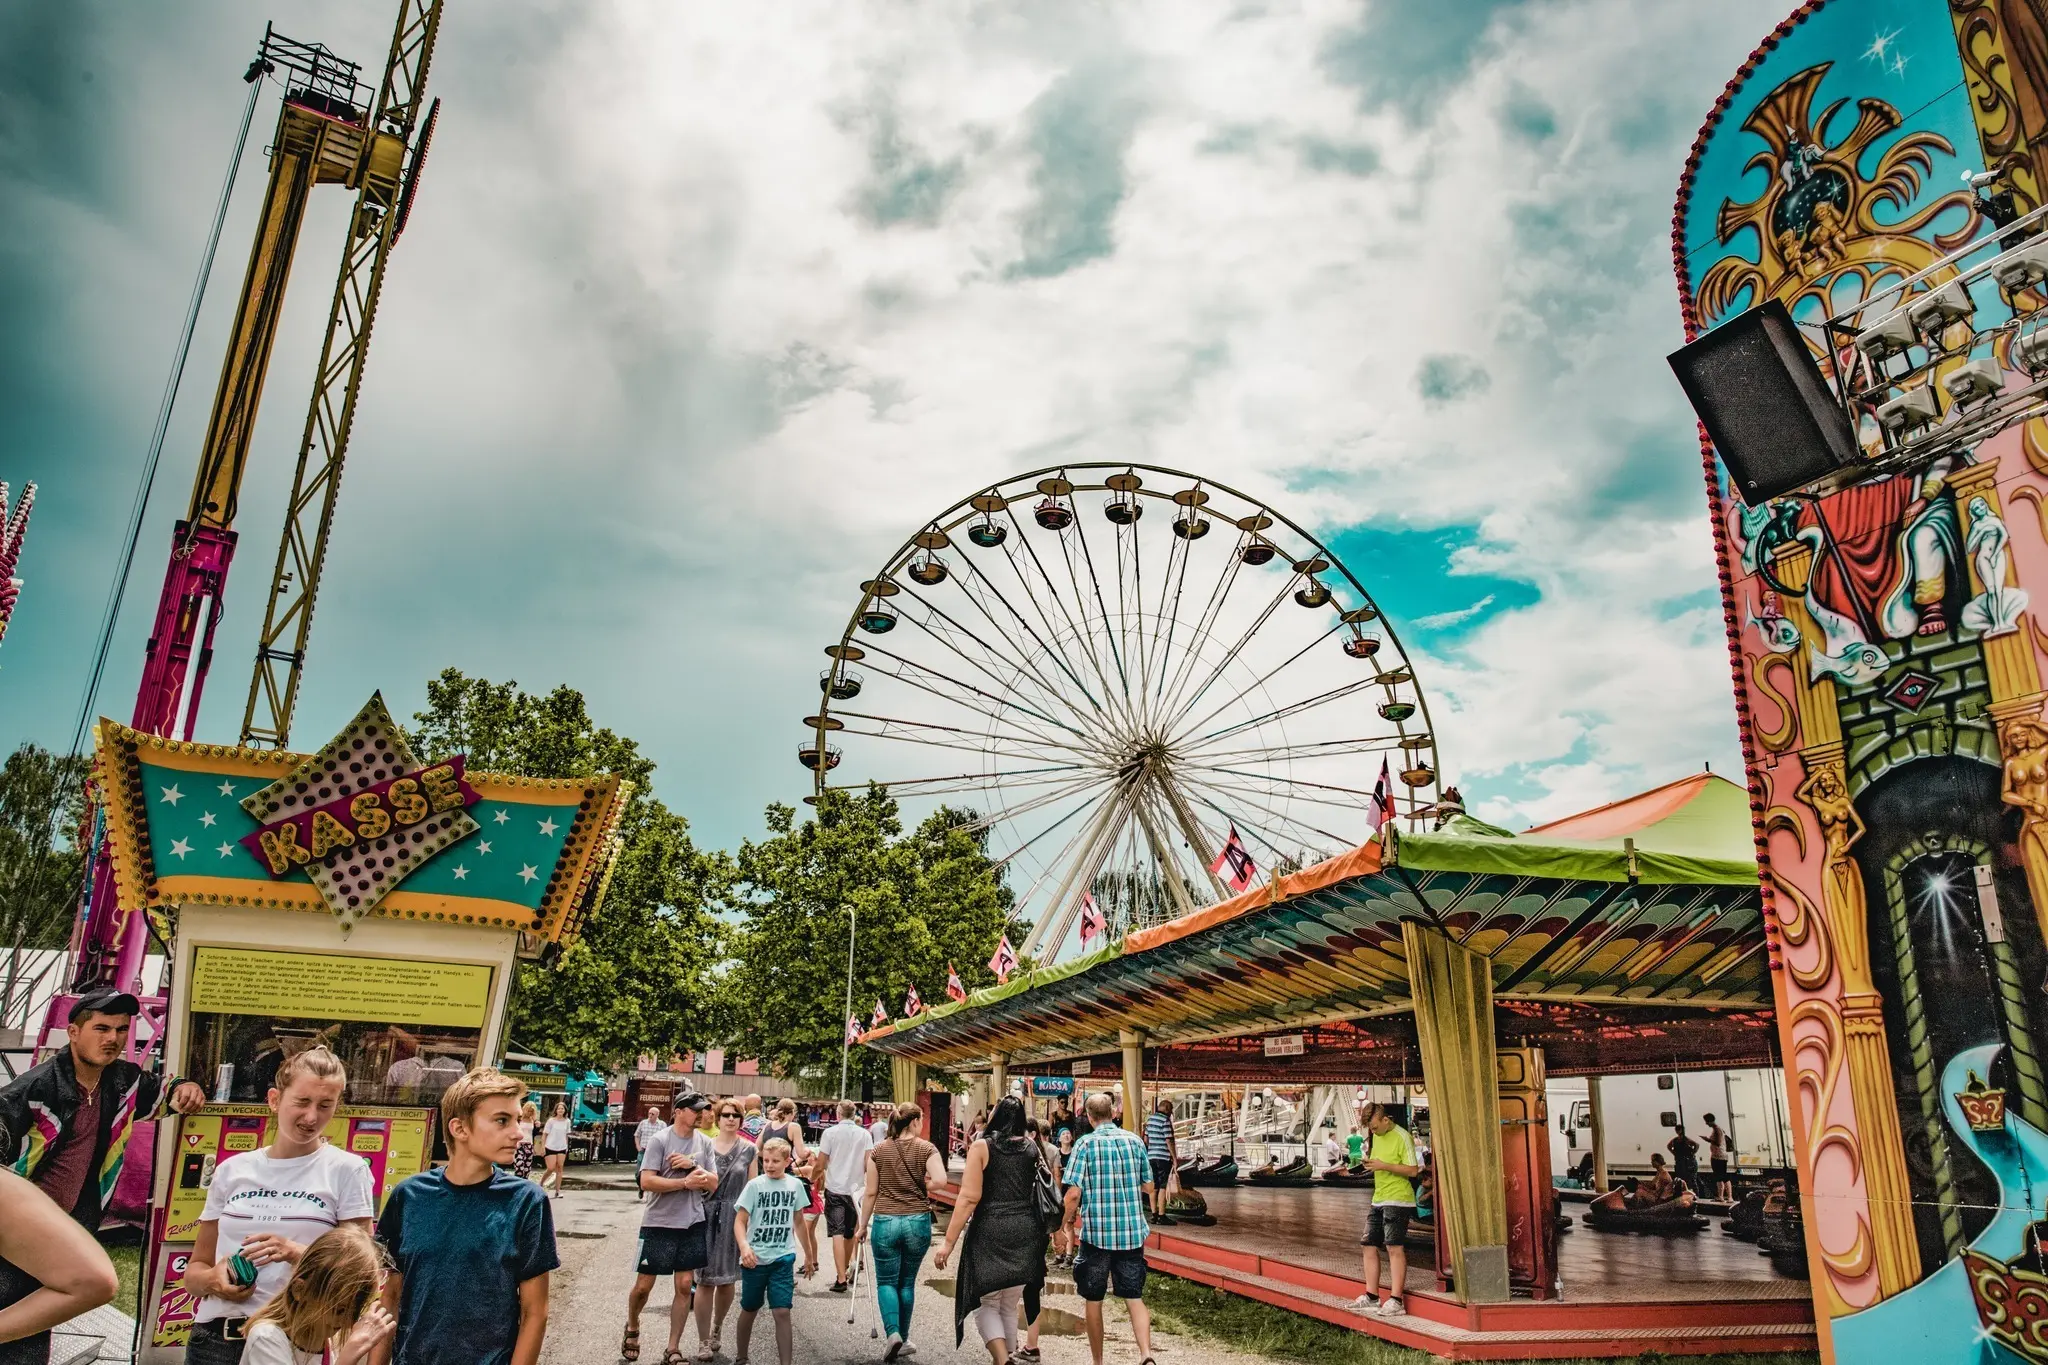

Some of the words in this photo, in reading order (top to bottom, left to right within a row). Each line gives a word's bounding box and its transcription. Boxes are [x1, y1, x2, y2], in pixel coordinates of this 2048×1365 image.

[259, 765, 465, 874] KASSE
[1039, 1081, 1068, 1090] KASSA
[640, 1094, 670, 1102] FEUERWEHR
[758, 1190, 796, 1208] MOVE
[760, 1209, 790, 1226] AND
[752, 1227, 790, 1243] SURF
[176, 1258, 188, 1269] 2
